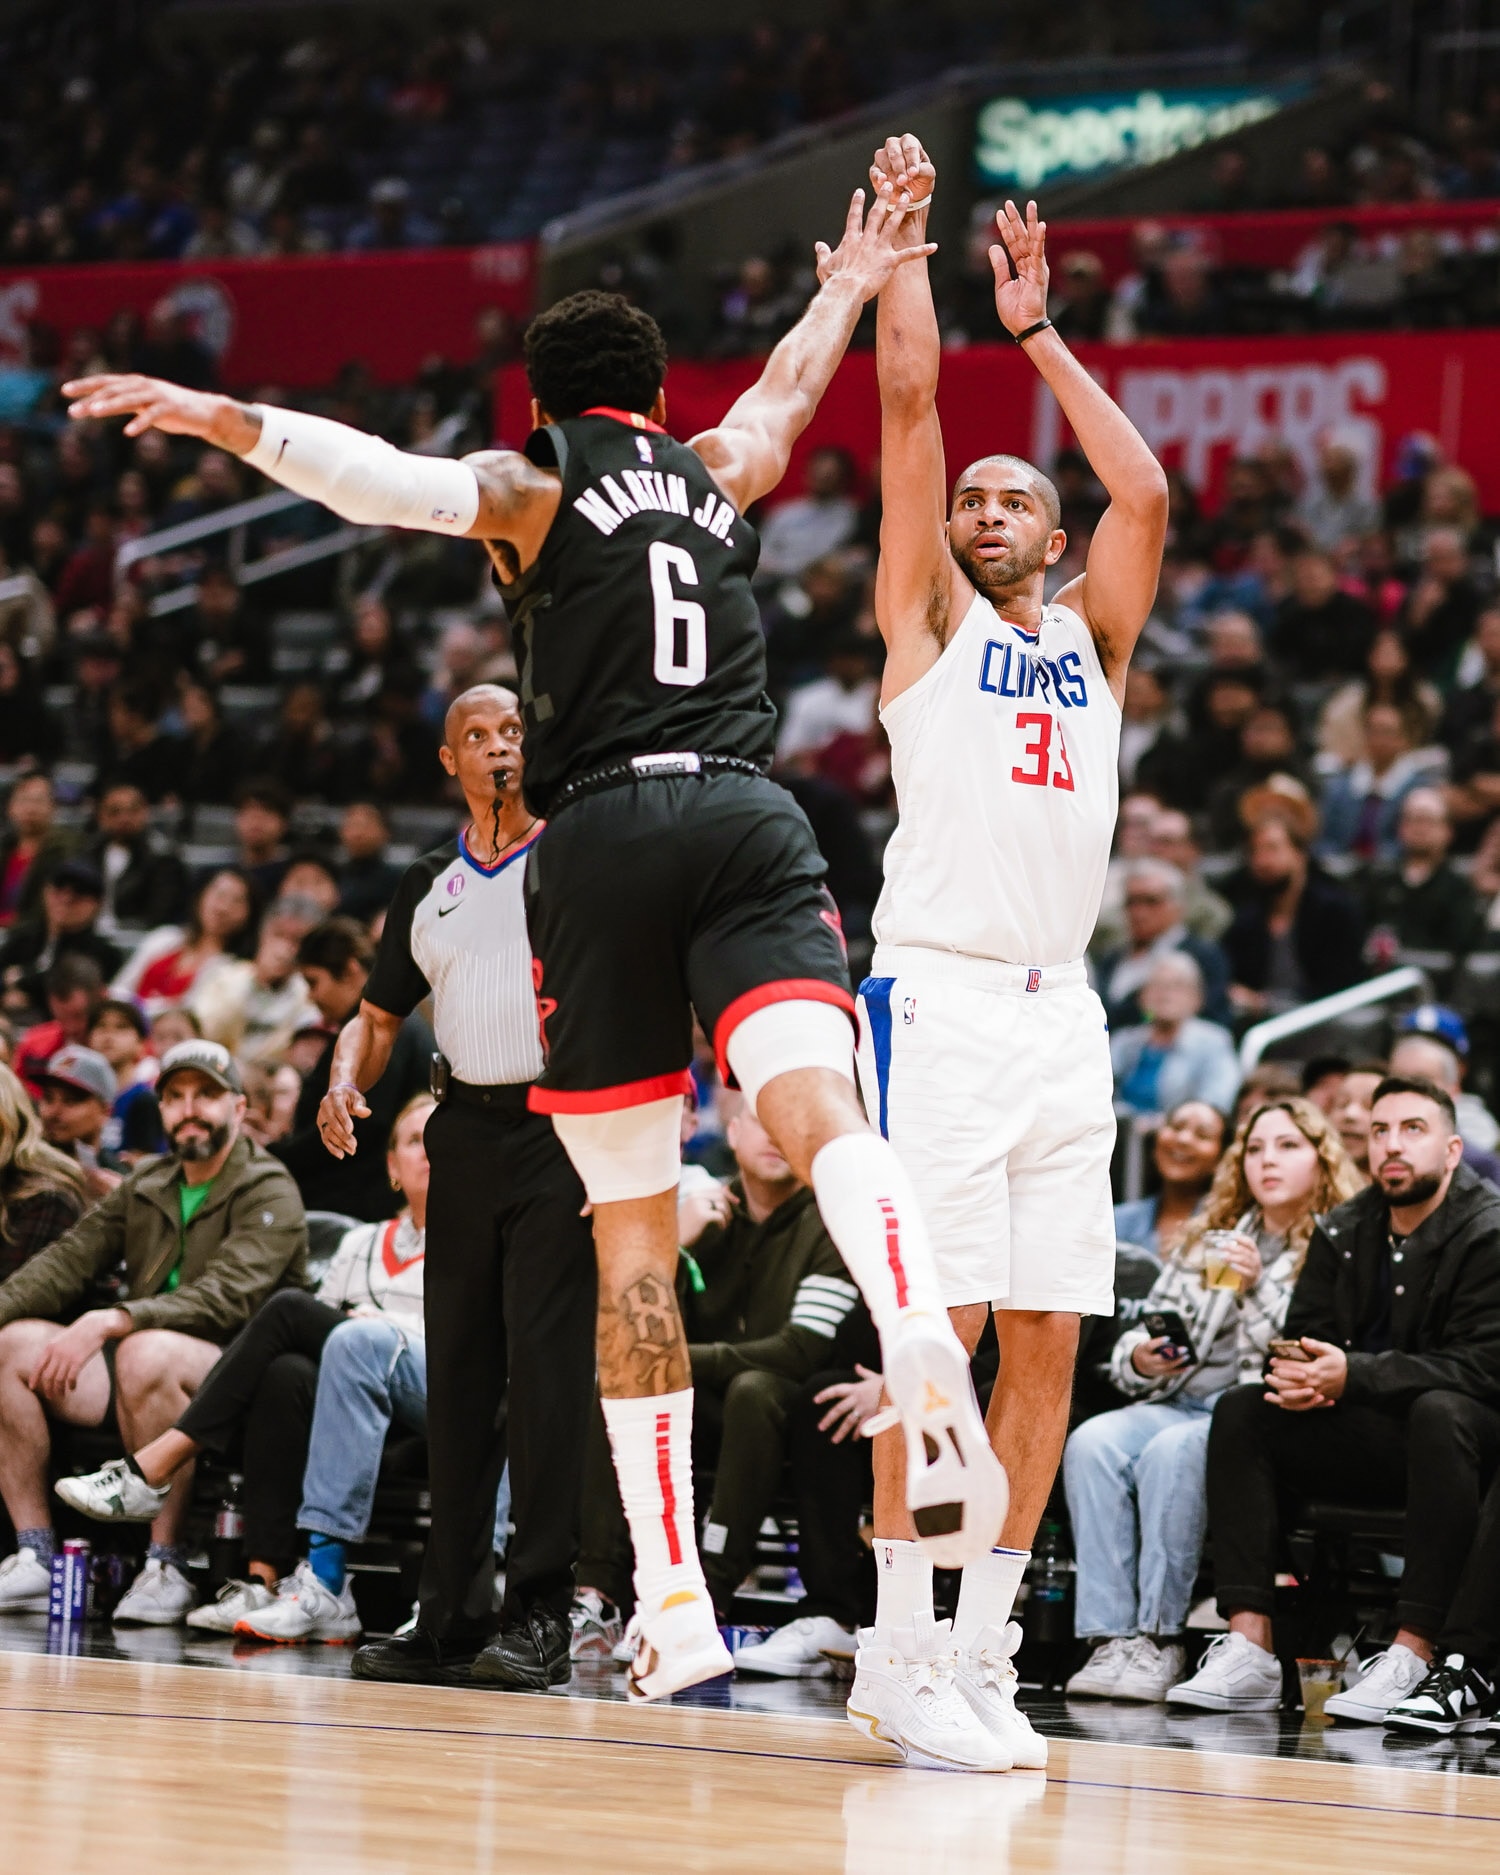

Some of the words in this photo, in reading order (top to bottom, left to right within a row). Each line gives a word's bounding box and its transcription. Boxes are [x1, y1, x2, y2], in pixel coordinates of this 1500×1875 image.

[1031, 356, 1387, 508] IPPERS
[573, 469, 690, 536] MARTIN
[693, 492, 736, 548] JR.
[648, 540, 707, 687] 6
[1011, 712, 1075, 792] 33
